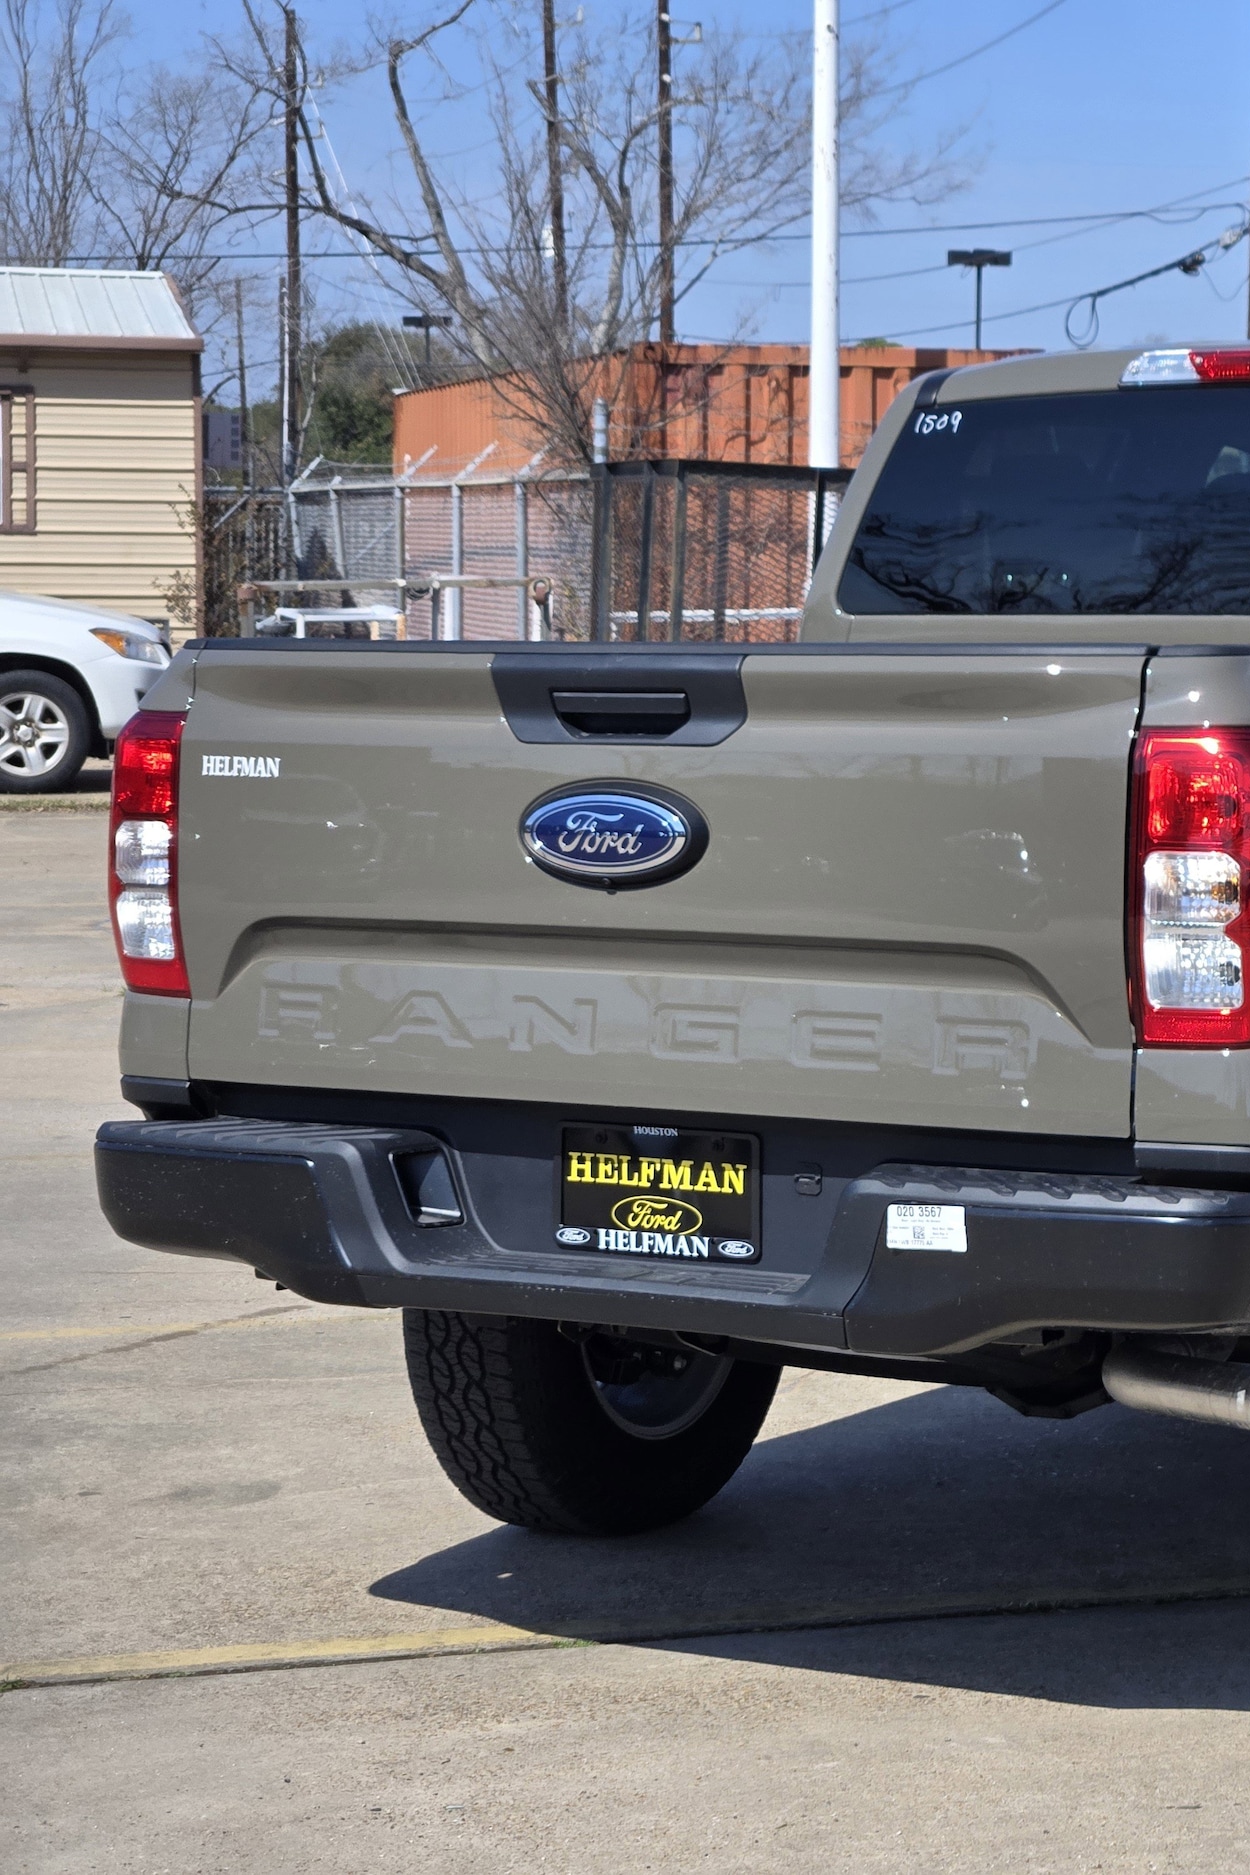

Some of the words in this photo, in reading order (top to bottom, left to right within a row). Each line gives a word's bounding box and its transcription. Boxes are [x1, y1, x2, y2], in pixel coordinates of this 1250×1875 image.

[914, 410, 963, 434] 1509
[201, 754, 281, 778] HELFMAN
[558, 811, 643, 855] Ford
[257, 981, 1032, 1080] RANGER
[633, 1125, 679, 1137] HOUSTON
[567, 1151, 748, 1195] HELFMAN
[627, 1199, 683, 1231] Ford
[896, 1205, 914, 1217] 020
[918, 1206, 942, 1218] 3567
[596, 1228, 711, 1258] HELFMAN
